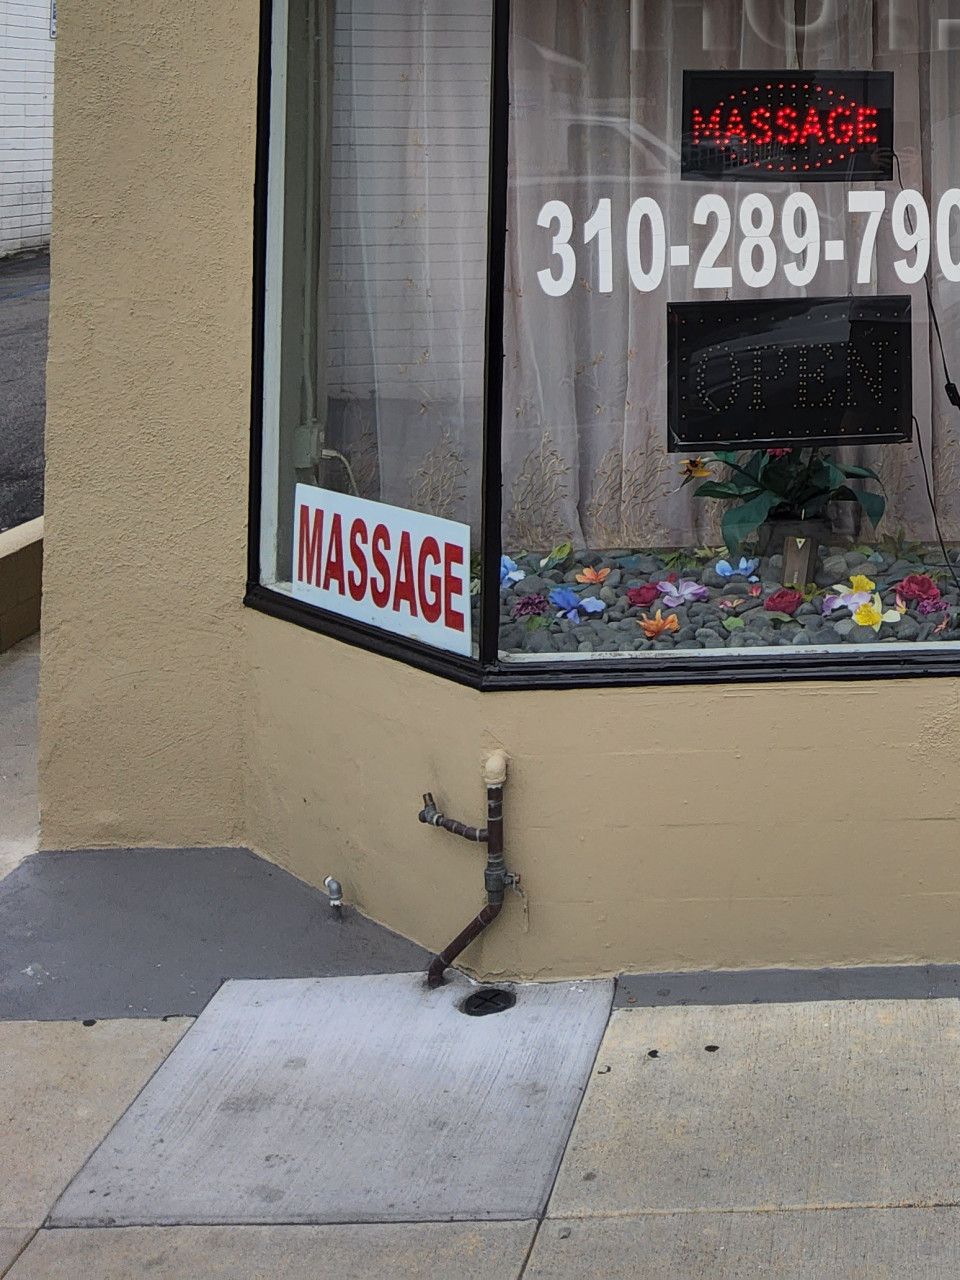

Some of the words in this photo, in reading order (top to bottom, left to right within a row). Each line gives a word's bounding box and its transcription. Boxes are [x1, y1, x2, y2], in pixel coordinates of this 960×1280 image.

[692, 106, 878, 145] MASSAGE
[696, 341, 889, 412] OPEN
[297, 504, 465, 632] MASSAGE
